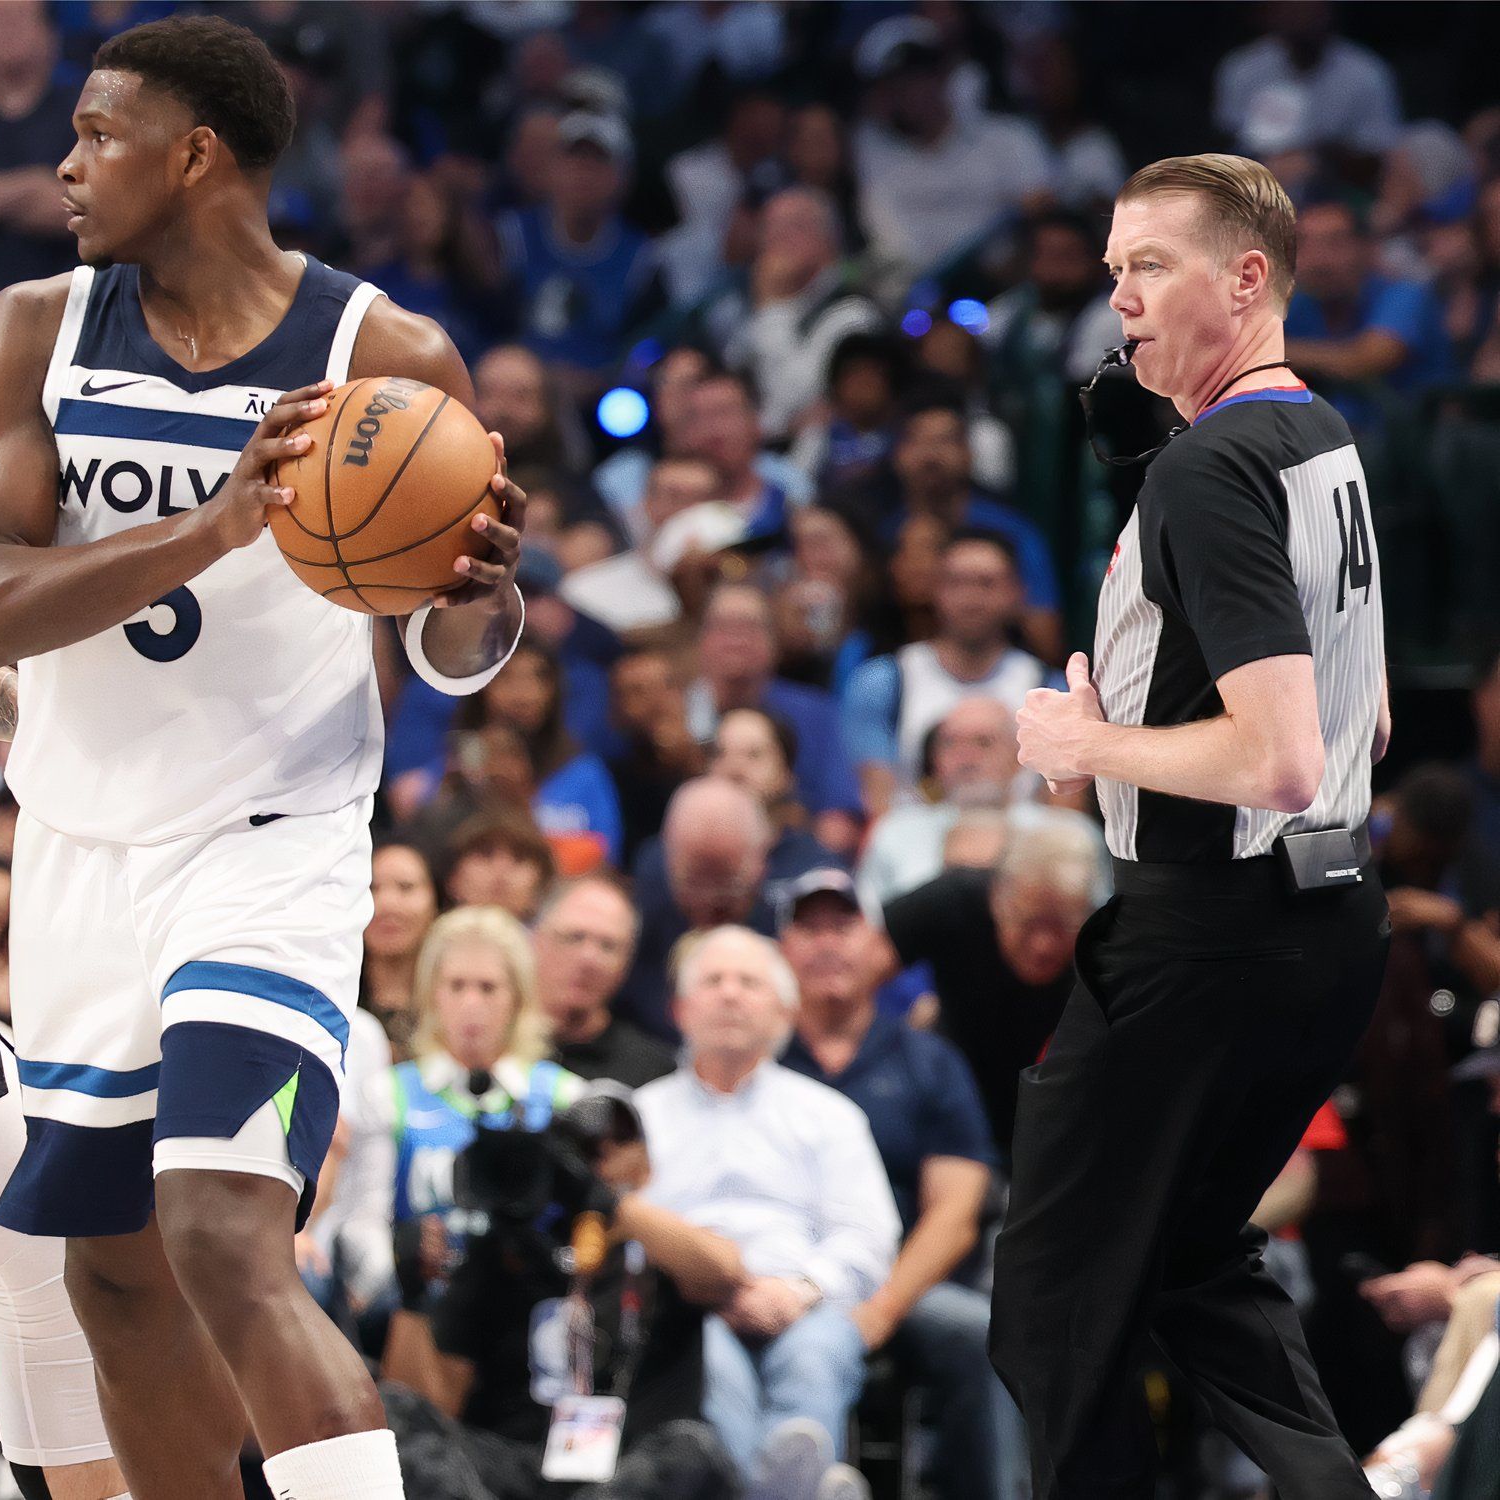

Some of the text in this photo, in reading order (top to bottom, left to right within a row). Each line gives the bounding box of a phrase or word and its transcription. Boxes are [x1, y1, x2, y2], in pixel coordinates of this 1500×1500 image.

[60, 456, 245, 520] WOLV
[1333, 482, 1372, 613] 14
[123, 584, 202, 662] 5
